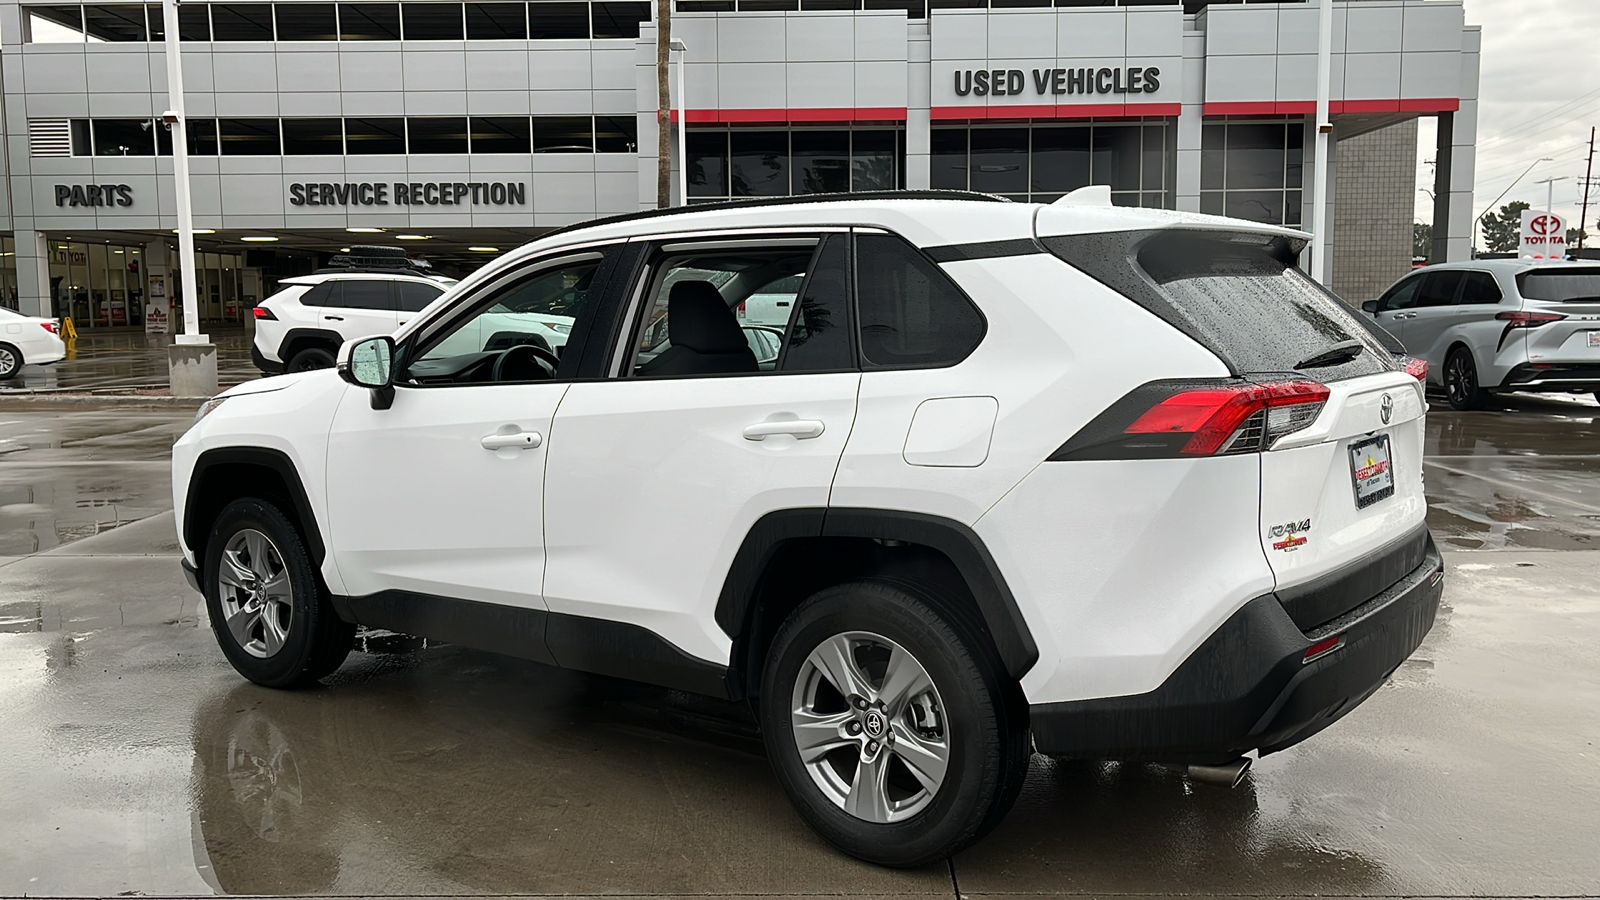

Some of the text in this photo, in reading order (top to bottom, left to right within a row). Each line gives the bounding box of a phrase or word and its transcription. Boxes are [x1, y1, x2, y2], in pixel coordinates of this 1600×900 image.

[954, 67, 1160, 96] USED VEHICLES
[54, 184, 133, 207] PARTS
[289, 183, 525, 206] SERVICE RECEPTION
[59, 251, 86, 262] TYOT
[1268, 517, 1311, 539] RAV4
